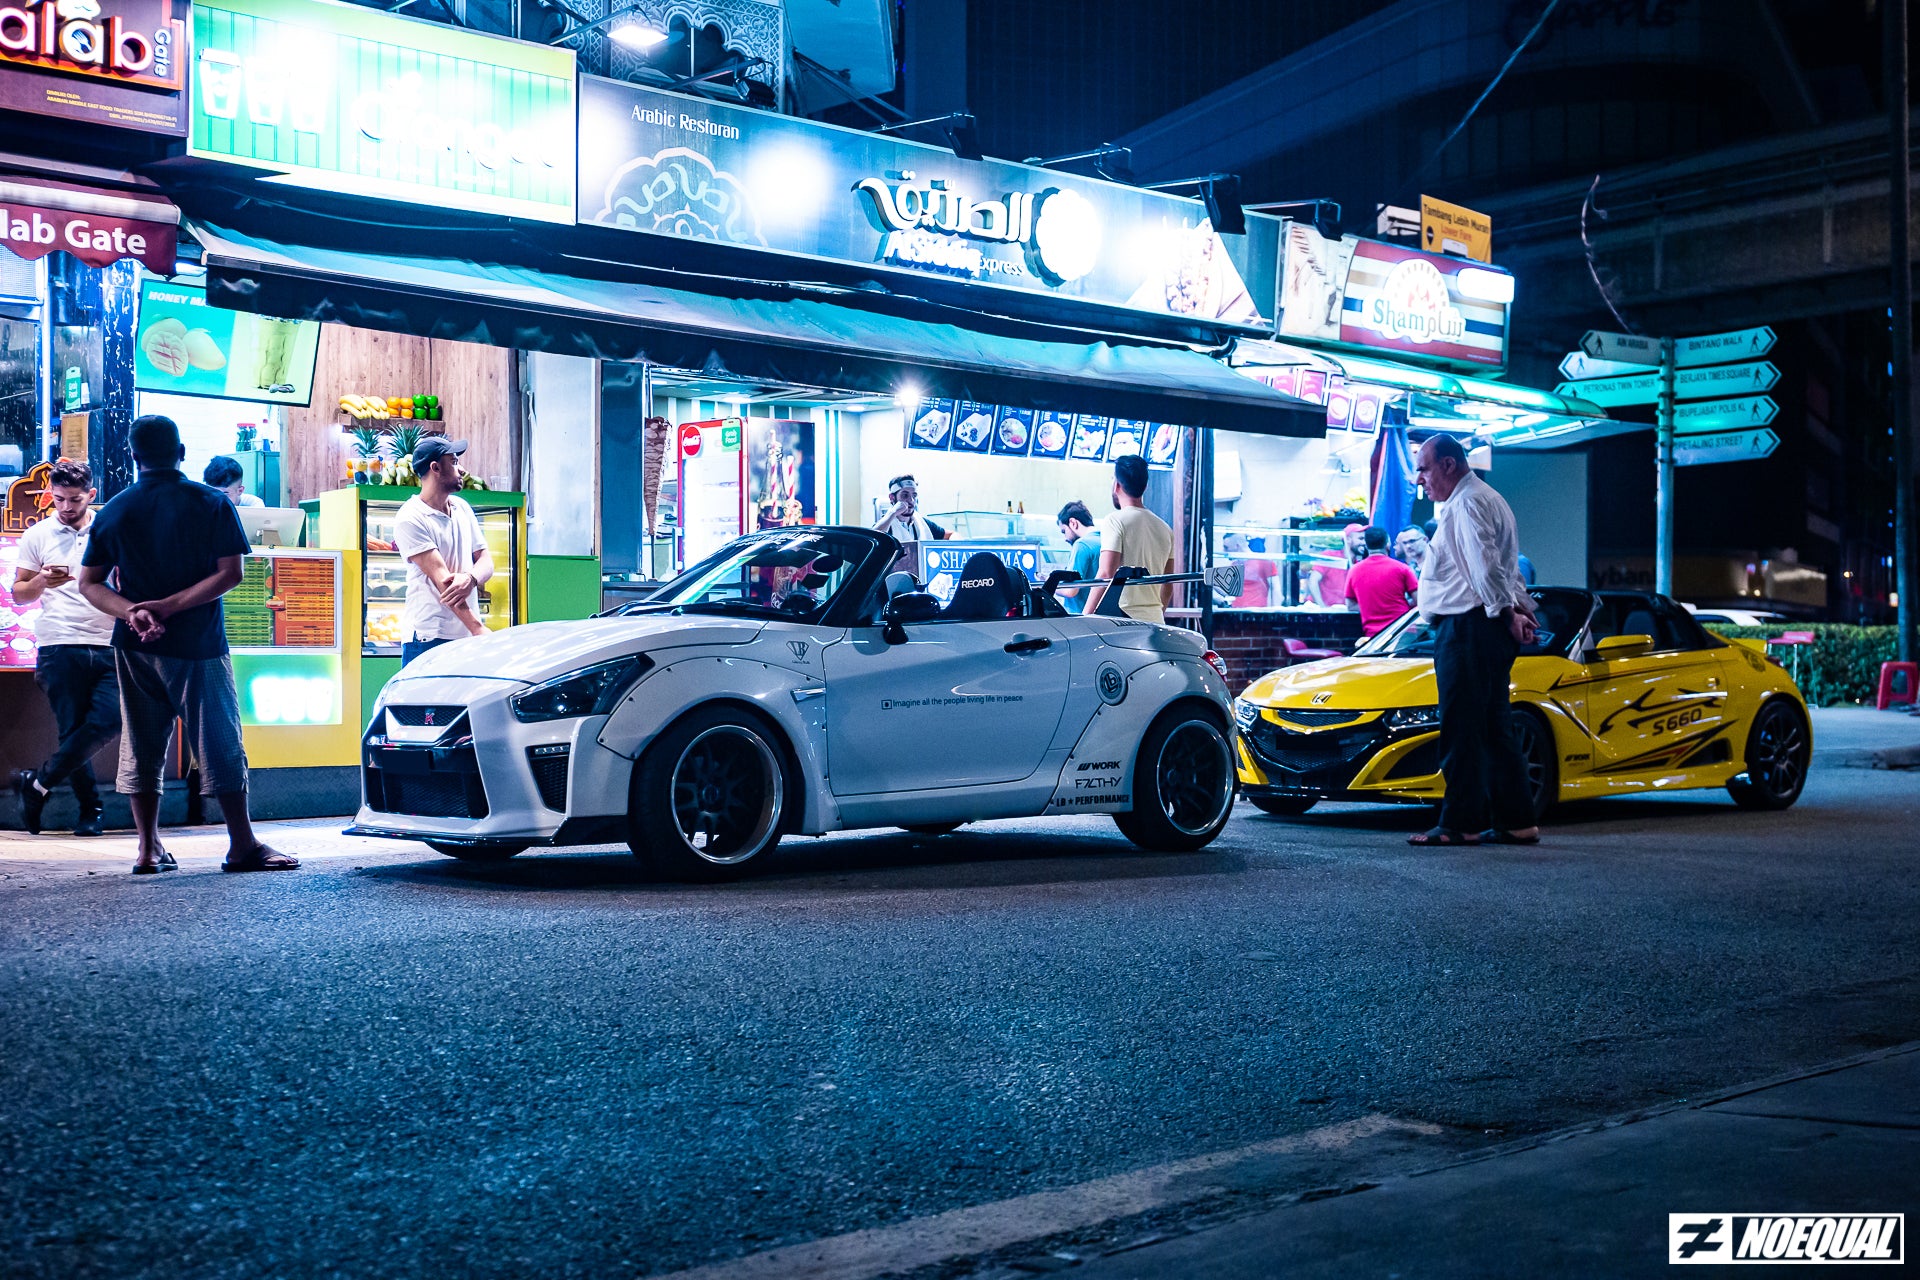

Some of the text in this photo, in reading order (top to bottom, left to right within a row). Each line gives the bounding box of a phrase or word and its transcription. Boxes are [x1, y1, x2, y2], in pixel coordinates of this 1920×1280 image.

[153, 28, 173, 78] Gate
[631, 104, 739, 140] Arabic Restoran
[64, 219, 147, 255] Gate
[148, 291, 189, 304] HONEY
[1688, 334, 1743, 350] BINTANG WALK
[1680, 367, 1751, 384] BERJAYA TIMES SQUARE
[1583, 379, 1656, 393] PETRONAS TWIN TOWER
[1717, 405, 1736, 416] POLIS
[1737, 404, 1746, 413] KL
[725, 428, 737, 438] Grab
[725, 436, 737, 444] Food
[1715, 435, 1744, 447] STREET
[961, 577, 995, 589] RECARO
[893, 694, 1024, 709] Imagine all the people living life in peace
[1652, 707, 1703, 737] S660
[1091, 760, 1121, 771] WORK
[1075, 793, 1131, 806] PERFORMANCE
